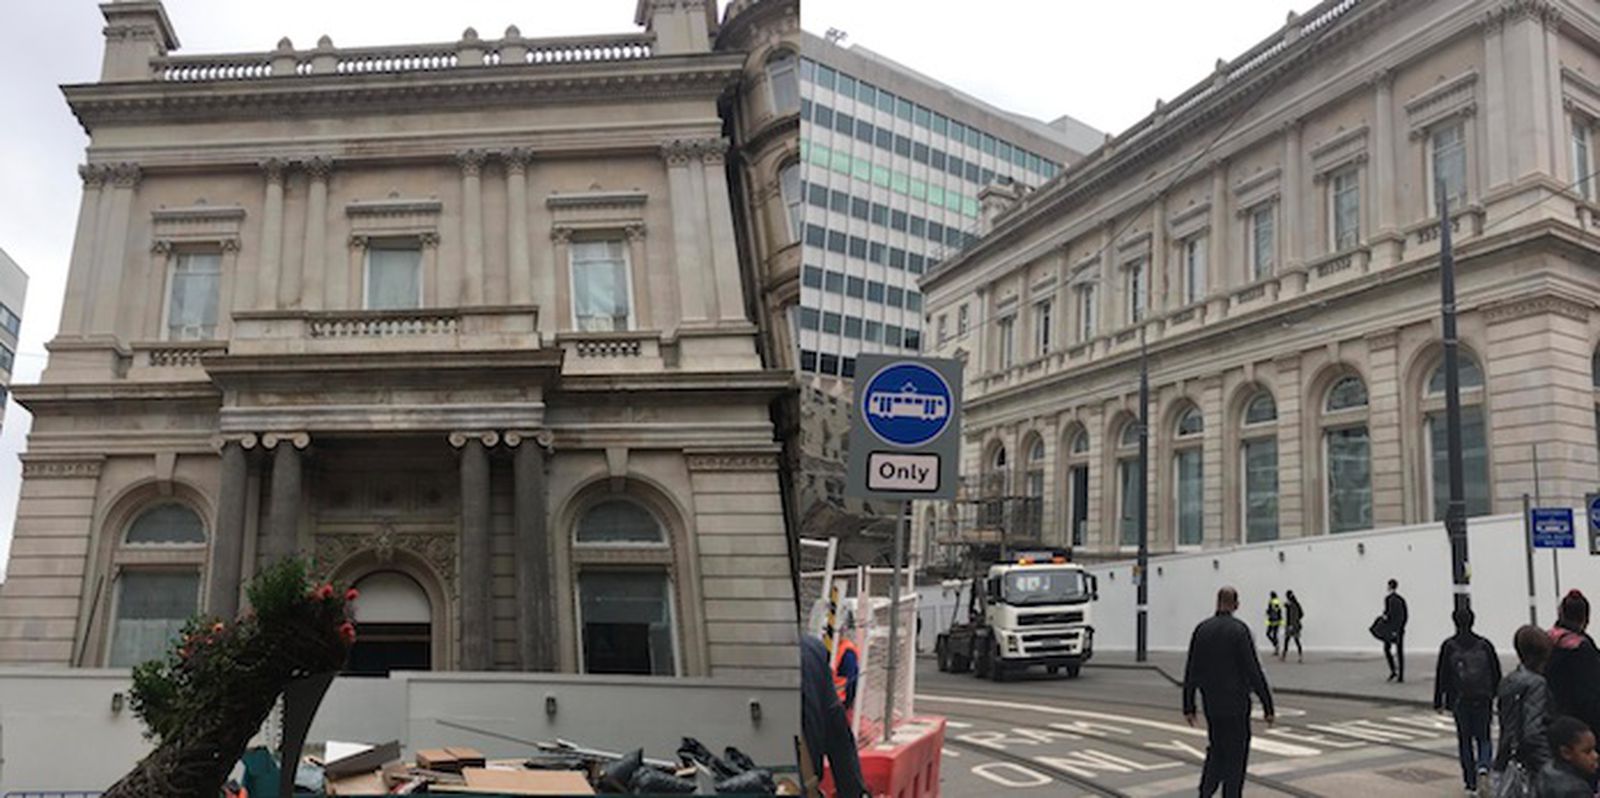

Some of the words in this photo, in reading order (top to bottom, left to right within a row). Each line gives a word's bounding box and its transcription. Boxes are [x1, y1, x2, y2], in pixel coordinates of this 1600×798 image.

[879, 461, 930, 484] Only
[942, 720, 1132, 756] RAM
[971, 739, 1208, 788] ONLY
